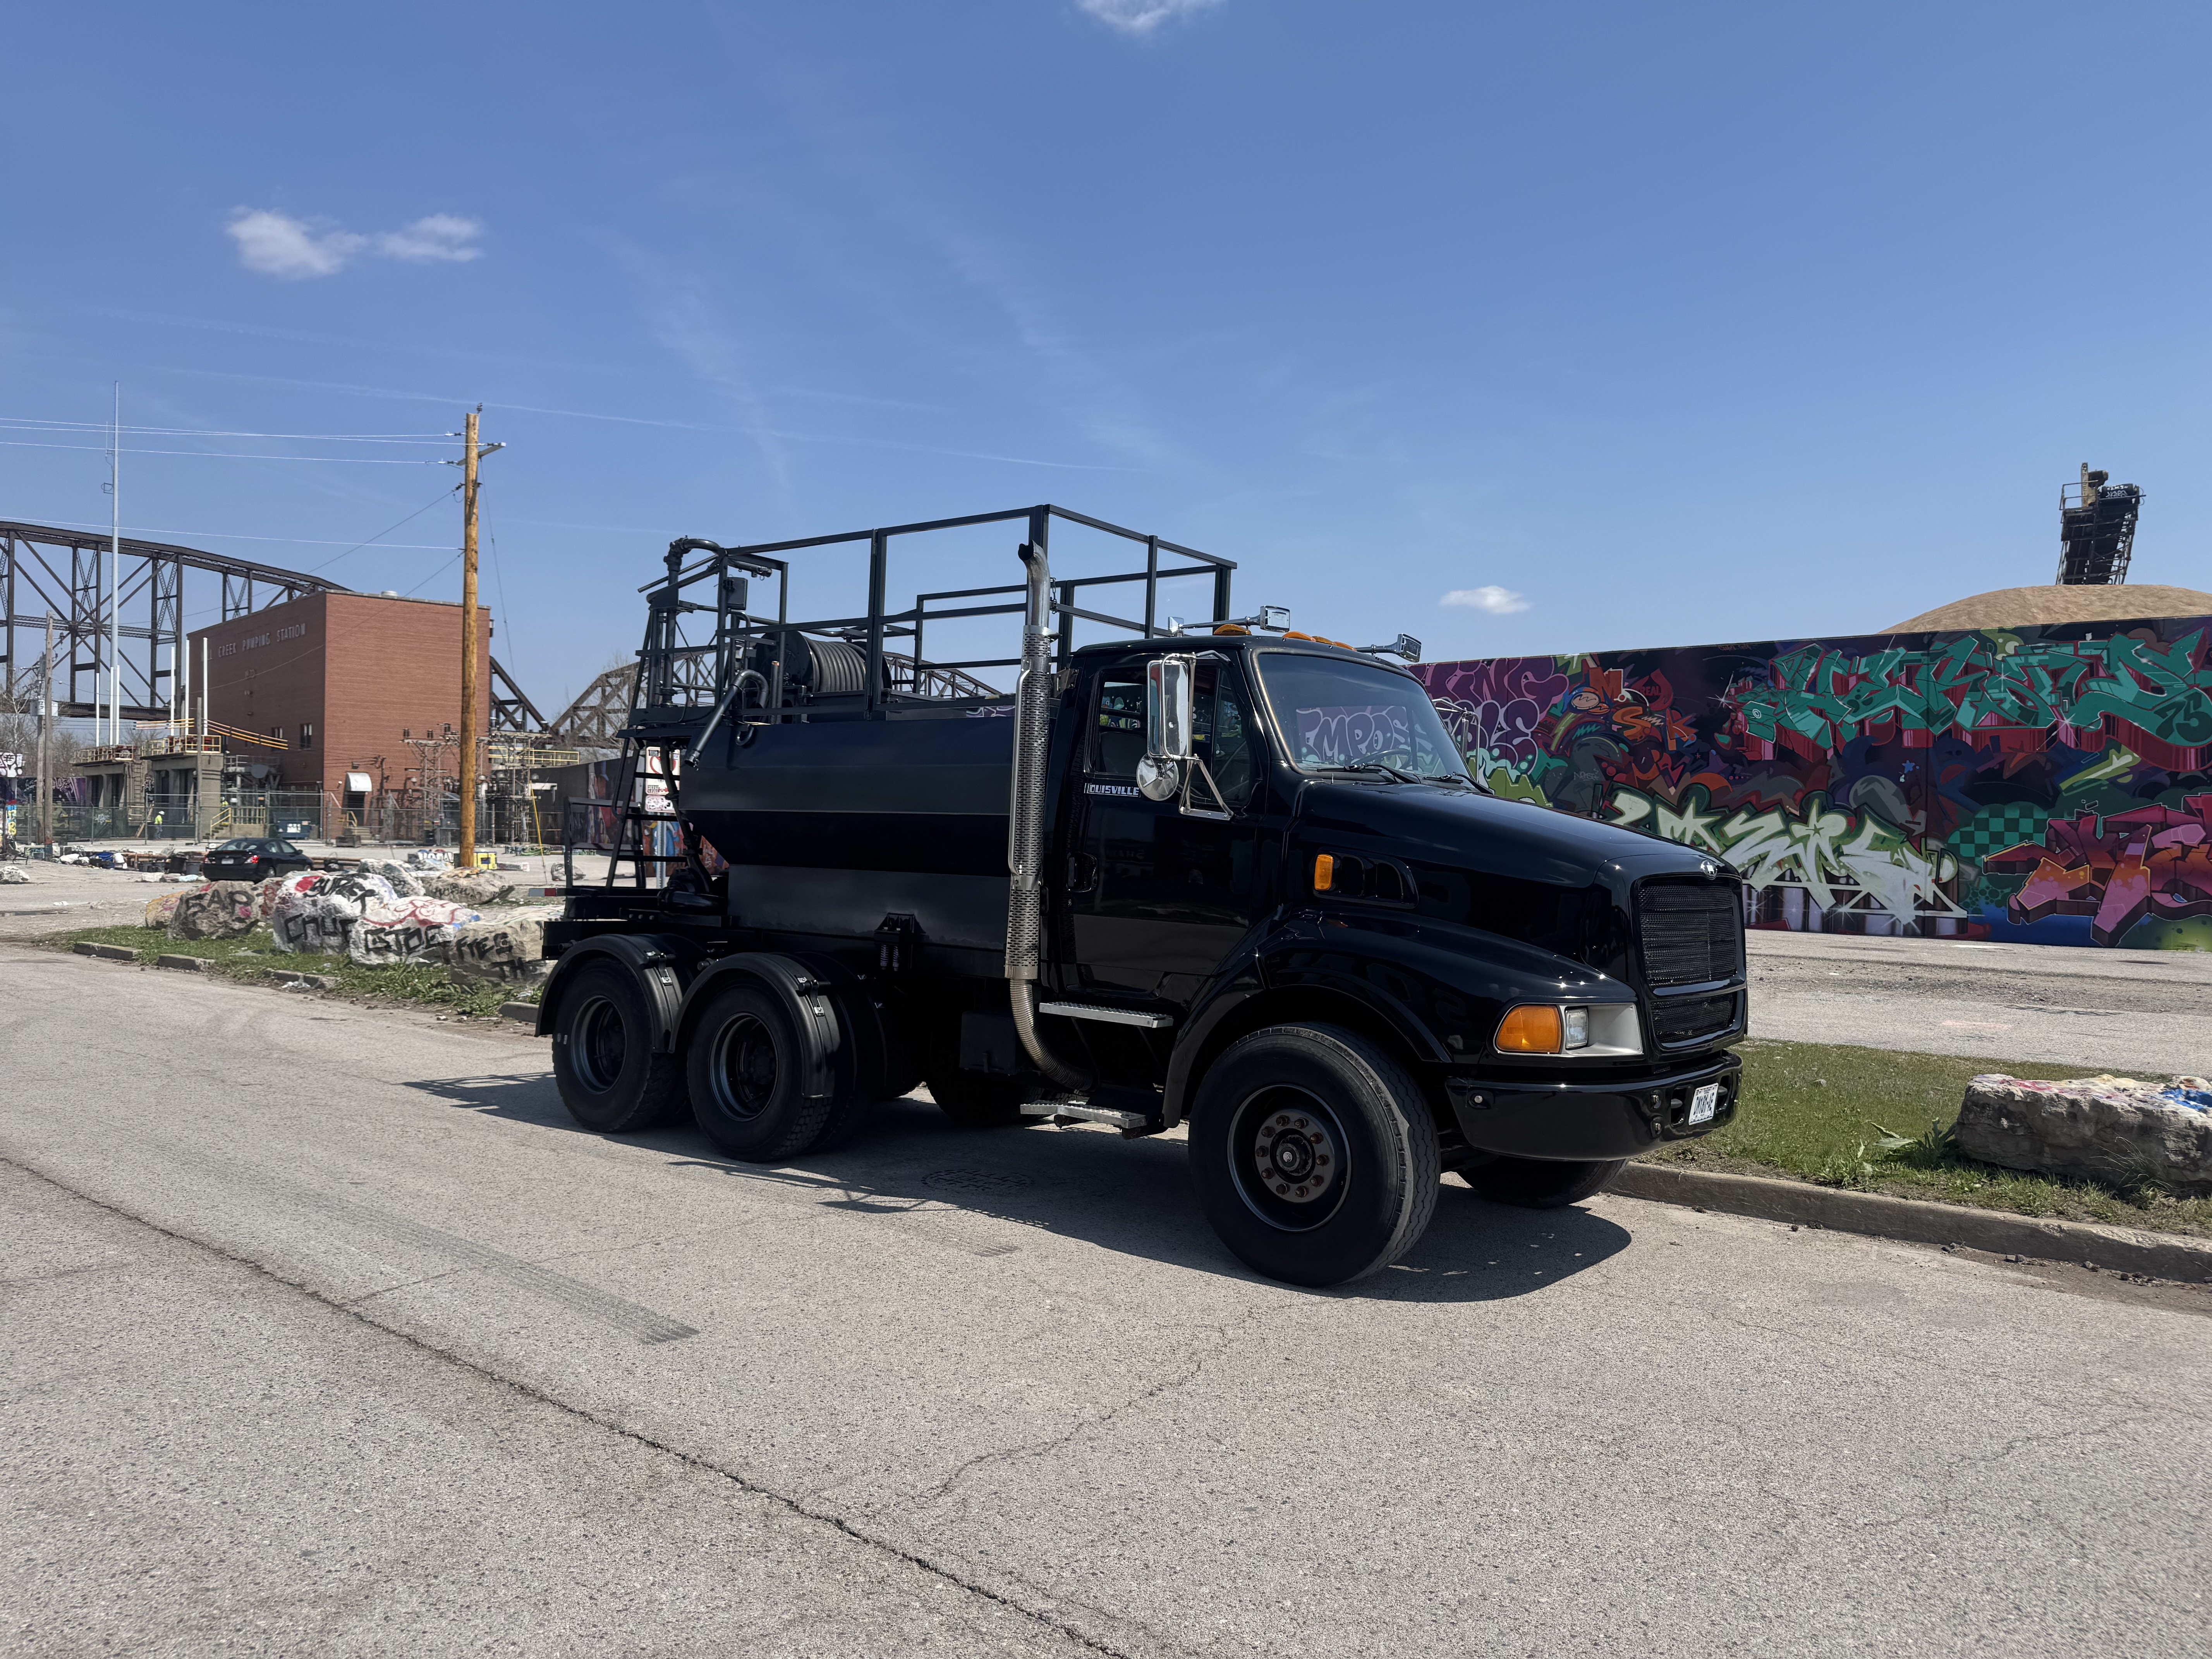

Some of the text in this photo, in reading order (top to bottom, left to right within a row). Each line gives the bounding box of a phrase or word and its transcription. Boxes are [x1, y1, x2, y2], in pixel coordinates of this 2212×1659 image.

[218, 643, 237, 658] CREEK
[242, 633, 271, 651] PUMPING
[276, 623, 306, 642] STATION
[1640, 685, 1661, 696] REAL
[2153, 691, 2212, 743] 75
[1084, 783, 1140, 797] LOUISVILLE
